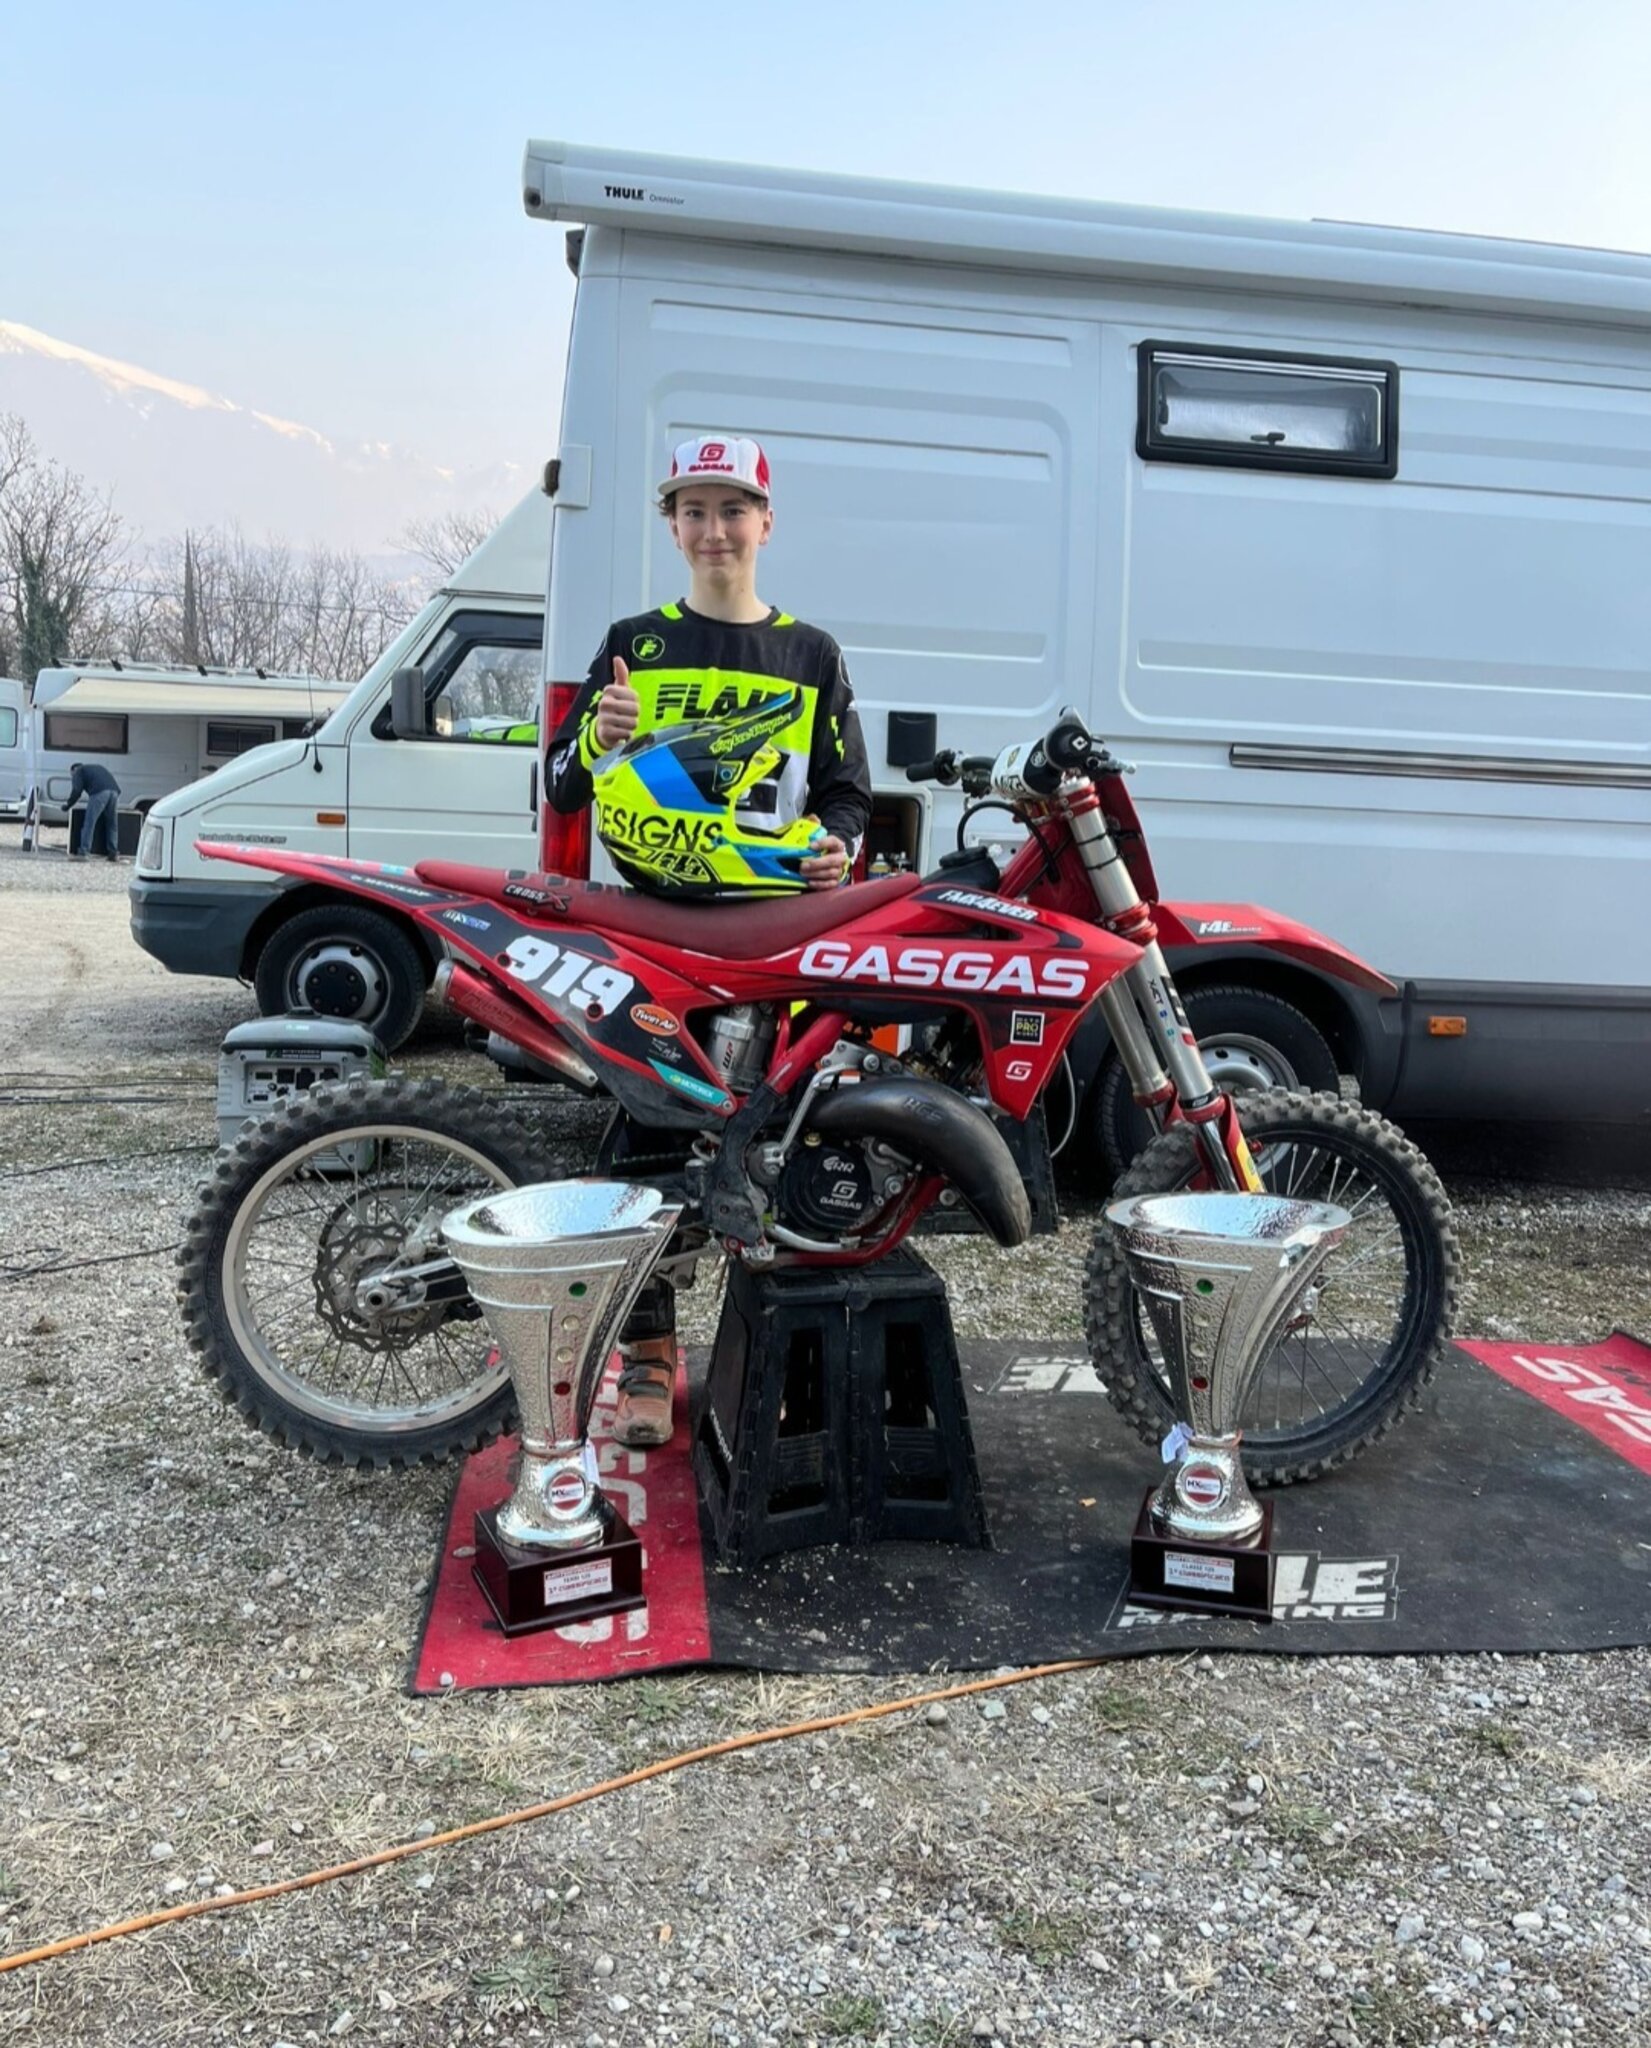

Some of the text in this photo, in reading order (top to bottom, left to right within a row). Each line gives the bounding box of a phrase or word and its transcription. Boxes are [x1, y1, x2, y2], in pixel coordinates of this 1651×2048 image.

[604, 185, 644, 201] THULE
[505, 935, 635, 1017] 919
[799, 940, 1091, 998] GASGAS
[635, 1008, 675, 1029] Twin Air
[1016, 1022, 1039, 1033] PRO
[820, 1197, 862, 1210] GASGAS
